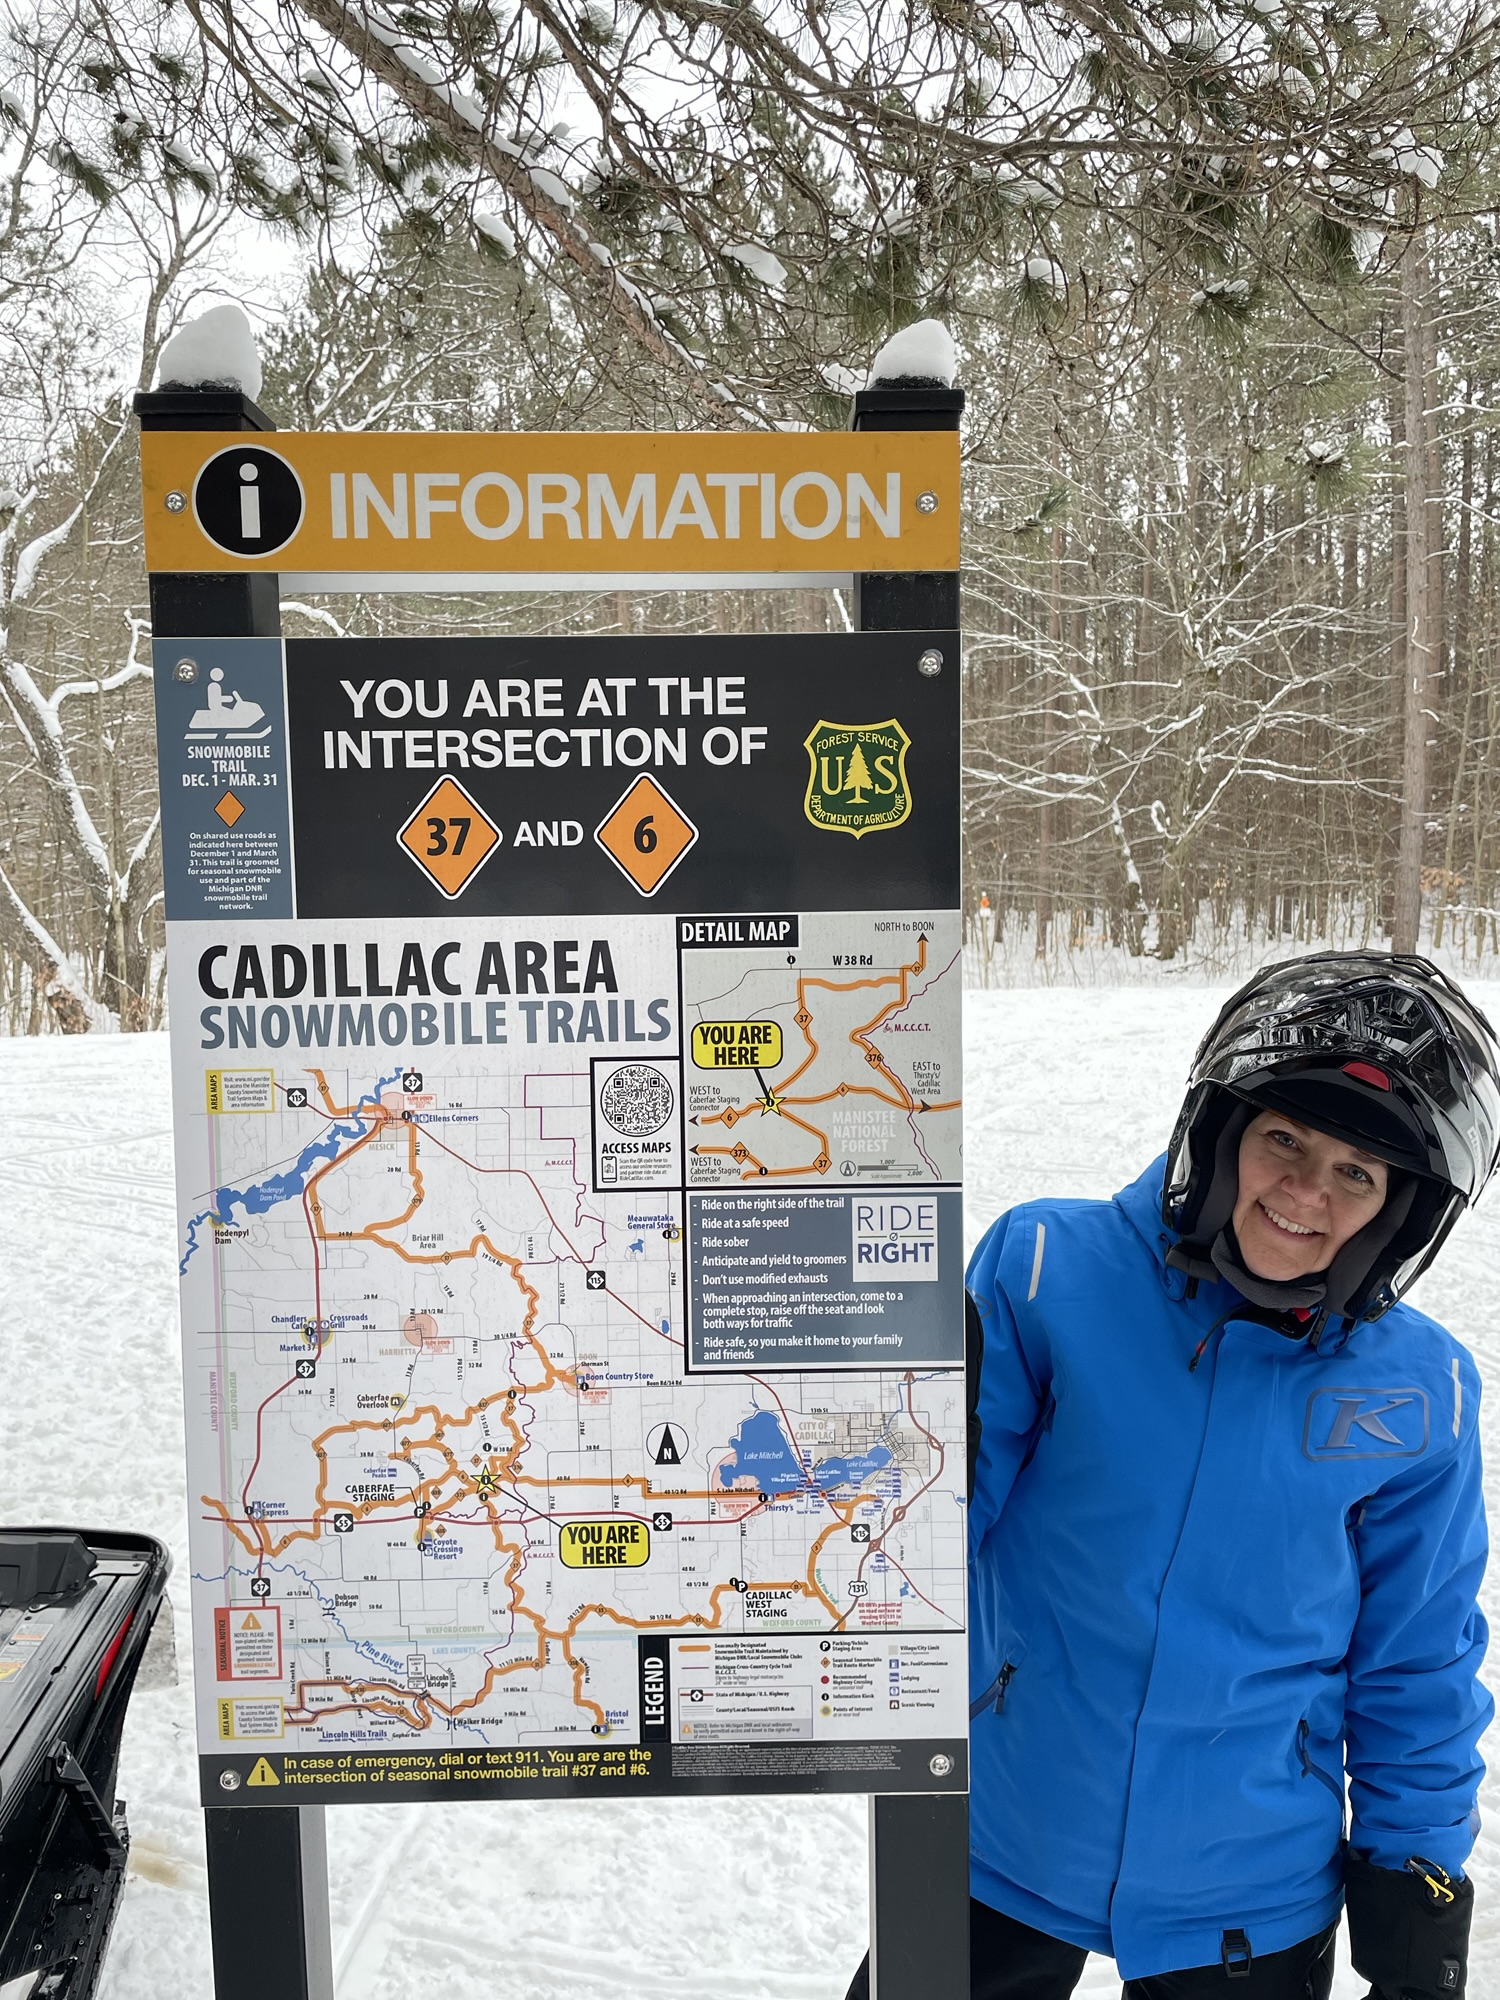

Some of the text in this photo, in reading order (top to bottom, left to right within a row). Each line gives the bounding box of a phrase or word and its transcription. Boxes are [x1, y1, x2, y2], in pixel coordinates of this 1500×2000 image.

[331, 472, 900, 540] INFORMATION
[340, 677, 746, 718] YOU ARE AT THE
[324, 727, 767, 768] INTERSECTION OF
[817, 732, 898, 753] FOREST SERVICE
[188, 746, 270, 758] SNOWMOBILE
[212, 760, 247, 772] TRAIL
[183, 774, 209, 786] DEC.
[212, 775, 218, 786] 1
[230, 774, 260, 786] MAR.
[264, 774, 276, 786] 31
[812, 794, 904, 825] DEPARTMENT OF AGRICULTURE
[427, 816, 657, 856] 37 AND 6
[682, 922, 790, 942] DETAIL MAP
[875, 922, 900, 931] NORTH
[913, 922, 934, 931] BOON
[833, 955, 872, 965] W 38 Rd
[198, 940, 618, 999] CADILLAC AREA
[200, 999, 671, 1049] SNOWMOBILE TRAILS
[799, 1014, 808, 1023] 37
[700, 1026, 772, 1045] YOU ARE
[714, 1046, 759, 1065] HERE
[868, 1054, 882, 1062] 376
[913, 1062, 931, 1071] EAST
[408, 1079, 417, 1087] 37
[690, 1086, 710, 1095] WEST
[717, 1096, 740, 1104] Staging
[832, 1111, 896, 1124] MANISTEE
[833, 1125, 896, 1138] NATIONAL
[602, 1142, 671, 1154] ACCESS MAPS
[842, 1139, 888, 1152] FOREST
[702, 1199, 722, 1210] Ride
[737, 1199, 752, 1209] the
[754, 1198, 776, 1211] right
[778, 1198, 796, 1208] side
[798, 1198, 808, 1208] of
[809, 1198, 824, 1208] the
[826, 1197, 844, 1208] trail
[628, 1214, 674, 1222] Meauwataka
[702, 1218, 722, 1228] Ride
[724, 1219, 733, 1228] at
[742, 1217, 760, 1228] safe
[762, 1217, 788, 1230] speed
[858, 1205, 934, 1231] RIDE
[215, 1230, 249, 1239] Hodenpyl
[702, 1236, 749, 1247] Ride sober
[858, 1243, 934, 1263] RIGHT
[702, 1254, 846, 1268] Anticipate and yield to groomers
[703, 1274, 727, 1284] Don't
[746, 1273, 786, 1284] modified
[788, 1273, 828, 1283] exhausts
[606, 1373, 632, 1382] Country
[664, 1448, 672, 1459] N
[759, 1452, 783, 1460] Mitchell
[345, 1484, 395, 1494] CABERFAE
[353, 1493, 395, 1502] STAGING
[764, 1504, 793, 1514] Thirsty's
[658, 1518, 668, 1527] 55
[567, 1526, 640, 1544] YOU ARE
[583, 1546, 627, 1564] HERE
[852, 1585, 864, 1593] 131
[746, 1591, 792, 1600] CADILLAC
[746, 1601, 771, 1609] WEST
[746, 1610, 787, 1618] STAGING
[362, 1641, 404, 1670] Pine River
[644, 1656, 664, 1726] LEGEND
[284, 1749, 651, 1769] In case of emergency, dial or text 911. You are are the
[284, 1764, 650, 1783] intersection of seasonal snowmobile trail #37 and #6.
